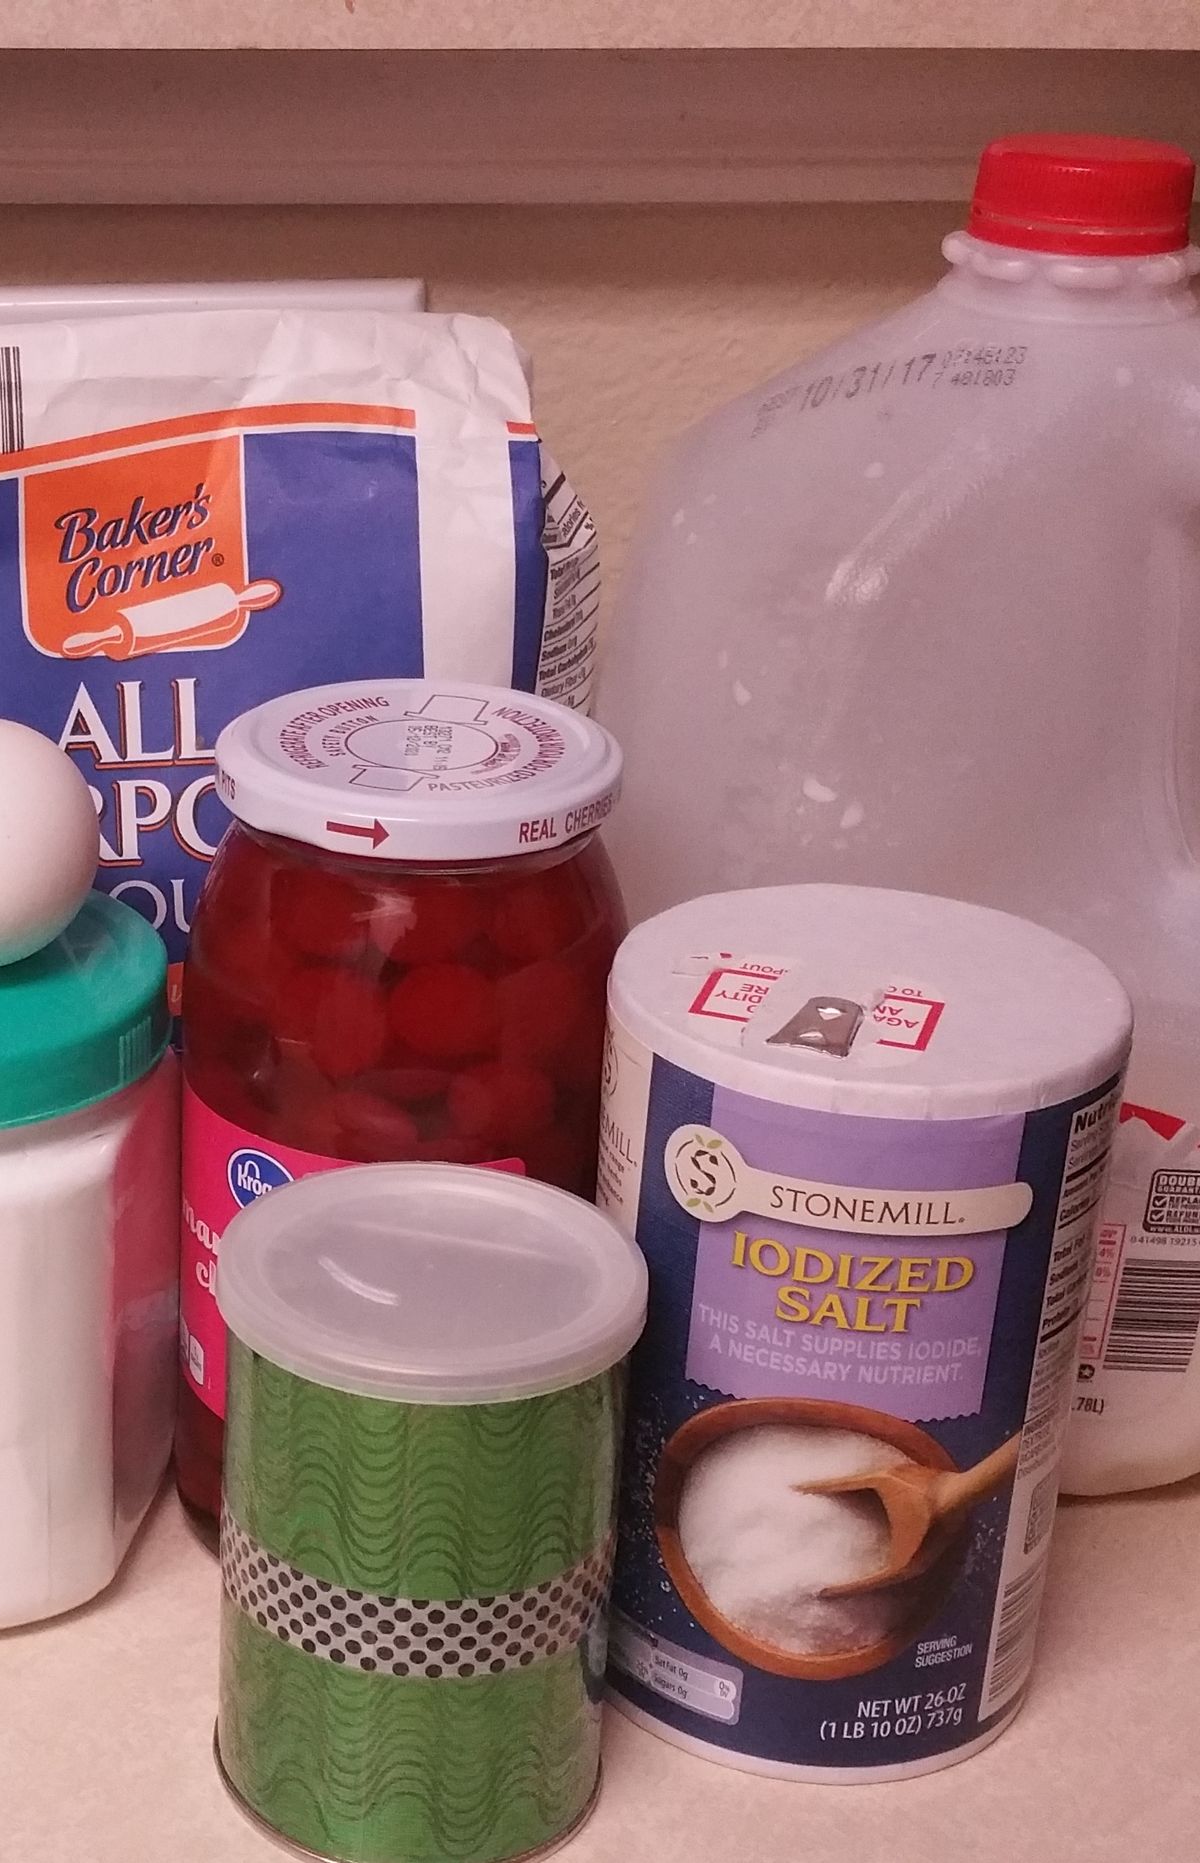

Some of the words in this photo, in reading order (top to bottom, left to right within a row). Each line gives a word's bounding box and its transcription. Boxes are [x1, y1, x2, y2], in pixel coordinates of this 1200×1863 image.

[54, 483, 212, 564] Baker's
[65, 537, 215, 614] Corner
[58, 677, 215, 769] ALL
[284, 708, 323, 732] AFTER
[319, 695, 390, 717] OPENING
[329, 714, 381, 735] BUTTON
[321, 734, 348, 757] SAFETY
[427, 769, 538, 792] PASTEURIZED
[490, 706, 566, 741] PROTECTION
[519, 816, 557, 844] REAL
[564, 793, 614, 834] CHERRIES
[740, 962, 788, 976] POUT
[714, 990, 763, 1004] DITY
[237, 1160, 274, 1198] Krog
[1160, 1175, 1200, 1187] DOUB
[770, 1185, 956, 1225] STONEMILL
[1169, 1196, 1200, 1205] REPLA
[1170, 1237, 1200, 1247] 19215
[731, 1230, 975, 1294] IODIZED
[775, 1285, 921, 1334] SALT
[699, 1304, 739, 1335] THIS
[745, 1319, 795, 1348] SALT
[801, 1334, 907, 1361] SUPPLIES
[709, 1335, 723, 1353] A
[728, 1340, 853, 1382] NECESSARY
[1071, 1396, 1105, 1415] .78L)
[914, 1643, 973, 1669] SUGGESTION
[916, 1635, 958, 1656] SERVING
[678, 1667, 689, 1681] 0g
[677, 1686, 688, 1699] 0g
[857, 1700, 892, 1719] NET
[895, 1695, 922, 1716] WT
[924, 1690, 944, 1710] 26
[947, 1682, 967, 1704] OZ
[819, 1720, 837, 1741] (1
[843, 1721, 865, 1739] LB
[870, 1720, 891, 1738] 10
[894, 1714, 923, 1735] OZ)
[926, 1707, 963, 1730] 737g
